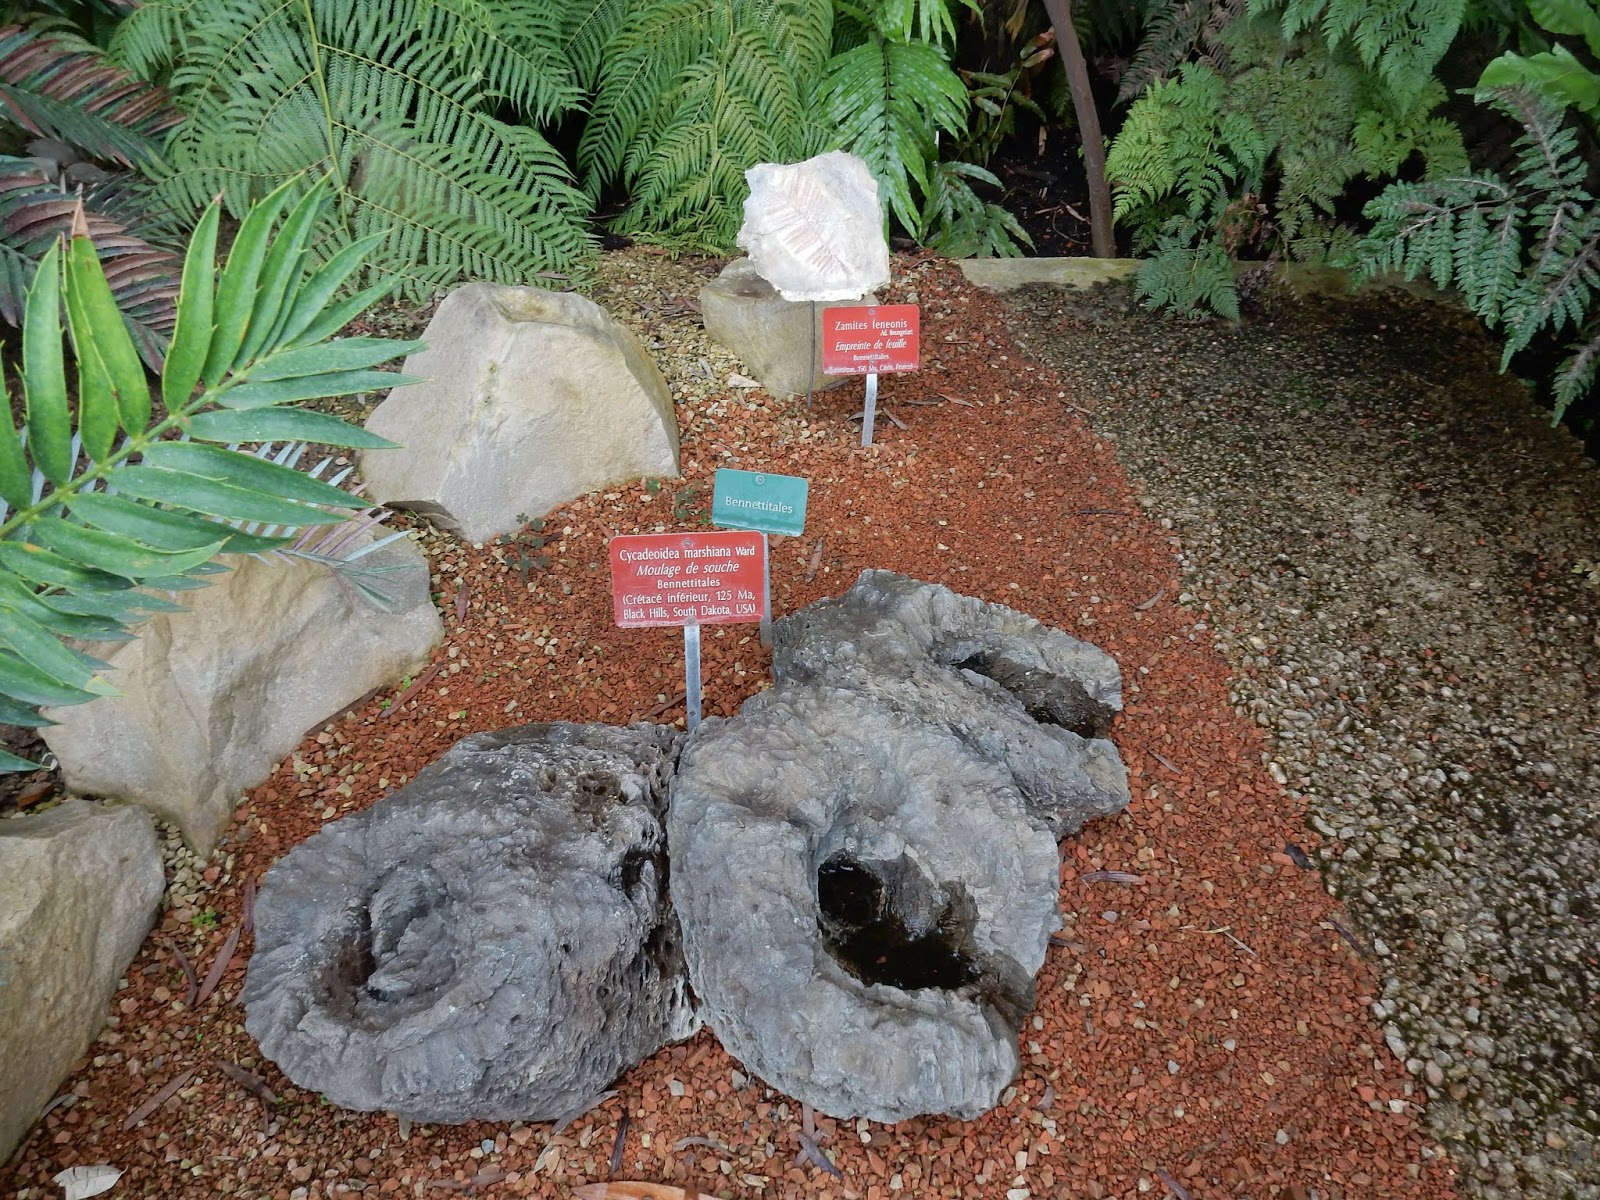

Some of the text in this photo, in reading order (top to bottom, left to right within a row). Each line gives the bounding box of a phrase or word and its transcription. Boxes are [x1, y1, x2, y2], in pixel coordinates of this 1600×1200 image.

[835, 319, 908, 331] Zamites feneonis
[835, 338, 907, 353] Empreinte de feuille
[725, 496, 793, 514] Bennettitales
[619, 545, 755, 563] Cycadeoidea marshiana Ward
[636, 560, 740, 578] Moulage de souche
[657, 577, 720, 589] Bennettitales
[623, 590, 756, 605] (Crétacé inférieur, 125 Ma,
[623, 603, 756, 619] Black Hills, South Dakota, USA)
